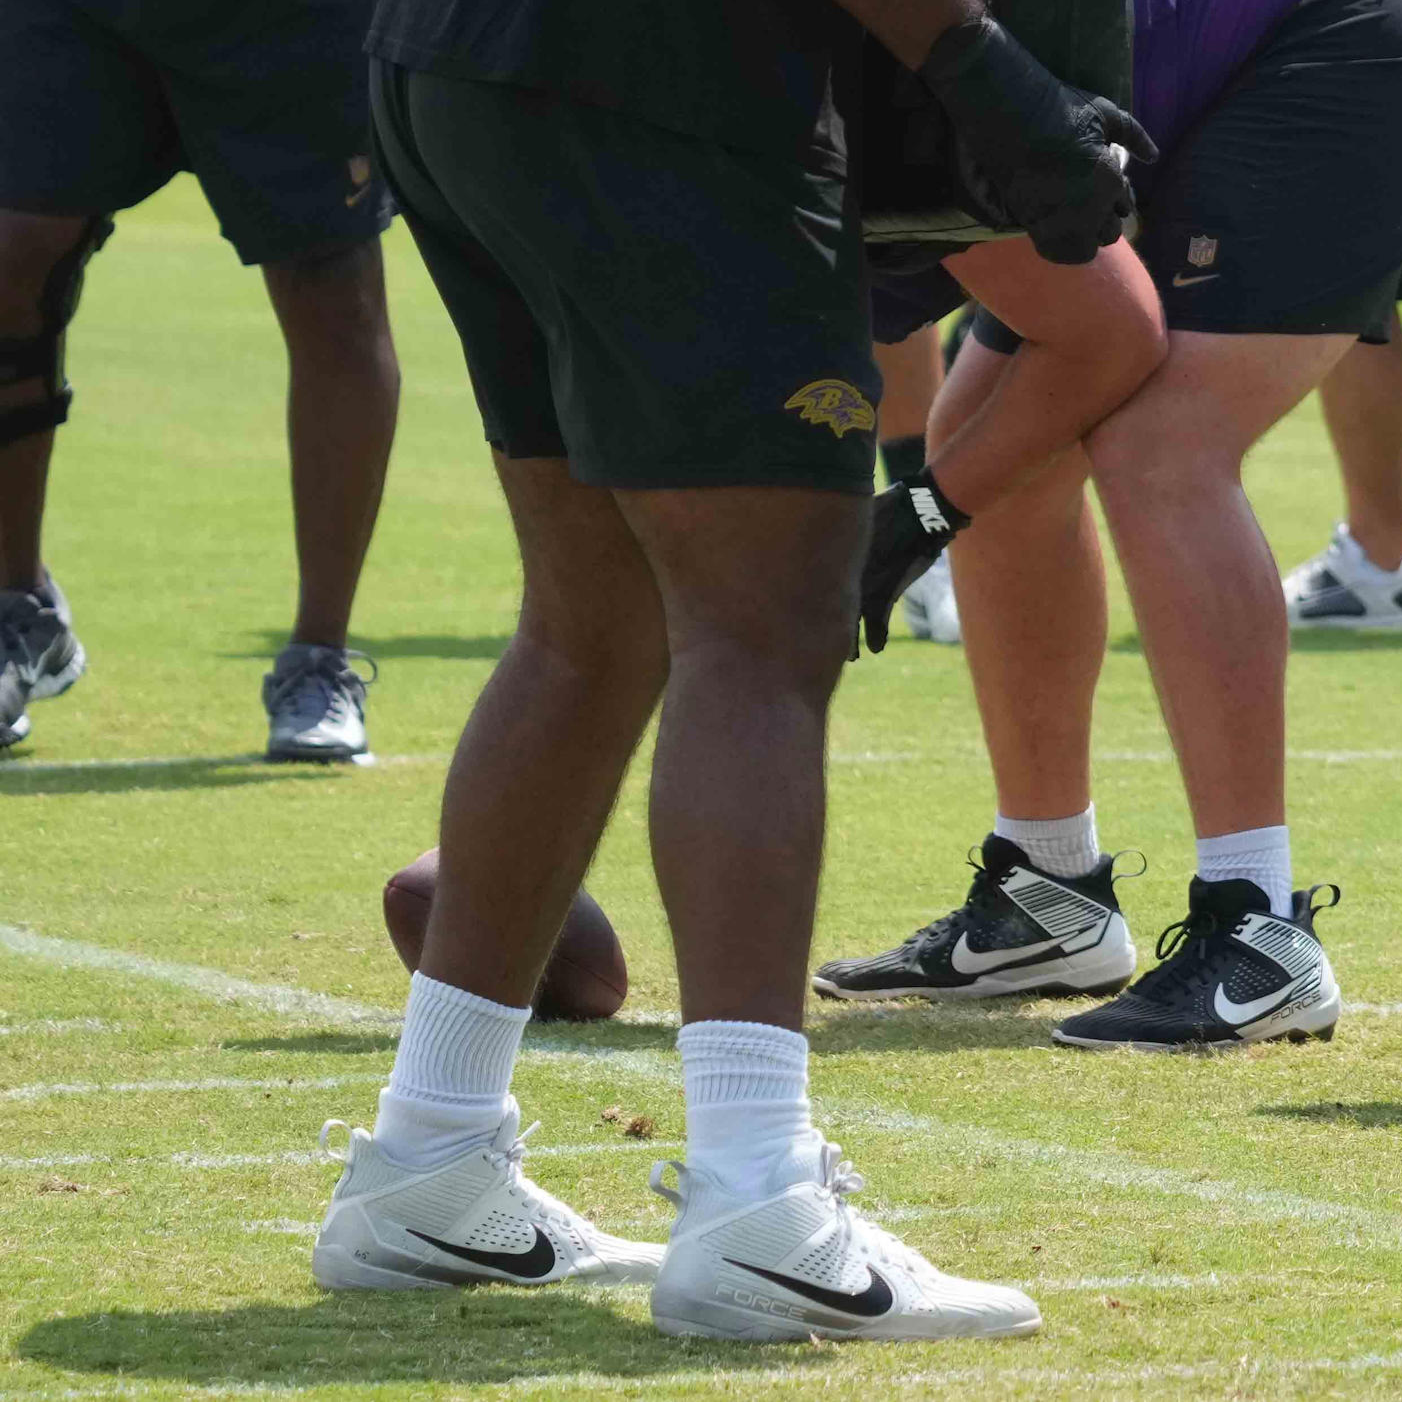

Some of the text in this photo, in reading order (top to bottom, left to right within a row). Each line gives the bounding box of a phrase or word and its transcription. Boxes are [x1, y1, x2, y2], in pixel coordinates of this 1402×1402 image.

[908, 487, 951, 535] NIKE
[1270, 989, 1322, 1025] FORCE
[713, 1282, 808, 1319] FORCE
